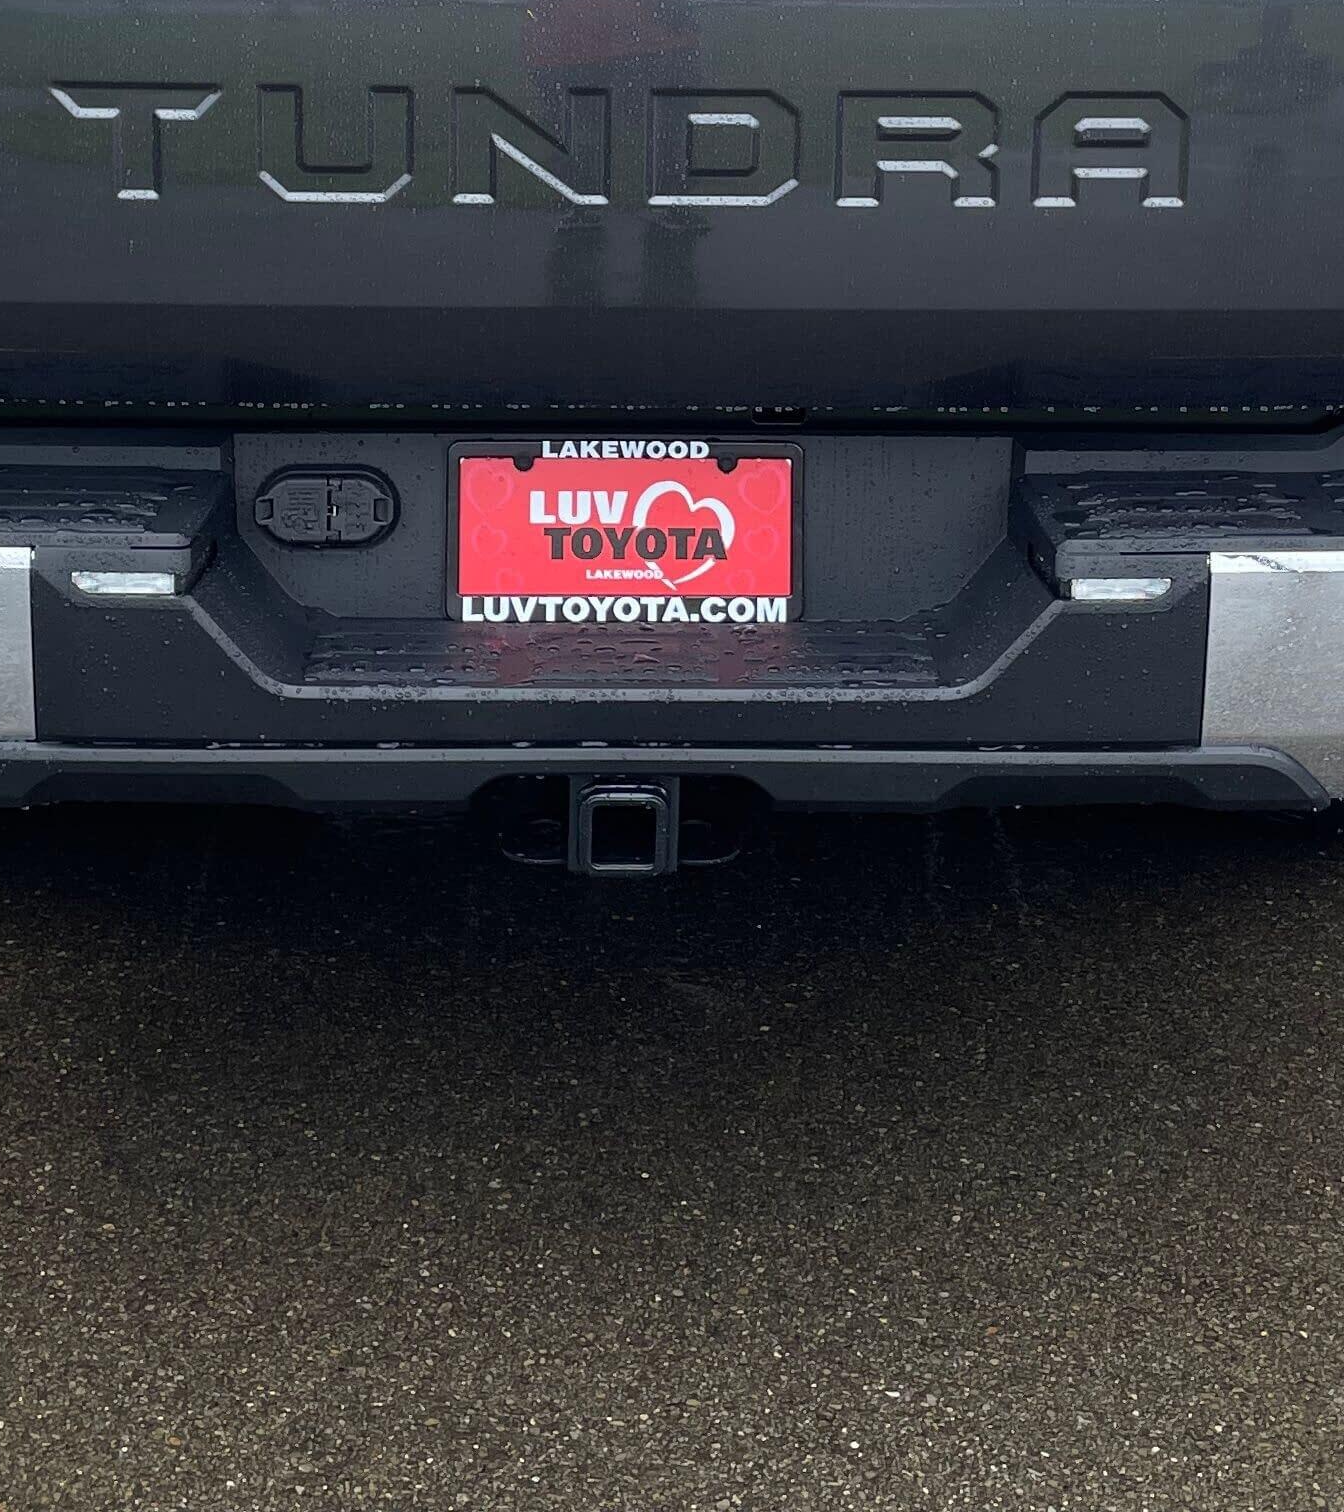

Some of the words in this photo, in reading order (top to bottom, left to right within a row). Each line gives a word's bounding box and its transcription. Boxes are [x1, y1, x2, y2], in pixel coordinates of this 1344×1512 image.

[50, 80, 1192, 209] TUNDRA
[542, 440, 710, 459] LAKEWOOD
[529, 490, 628, 525] LUV
[544, 526, 728, 561] TOYOTA
[585, 568, 664, 581] LAKEWOOD
[462, 596, 788, 623] LUVTOYOTA.COM
